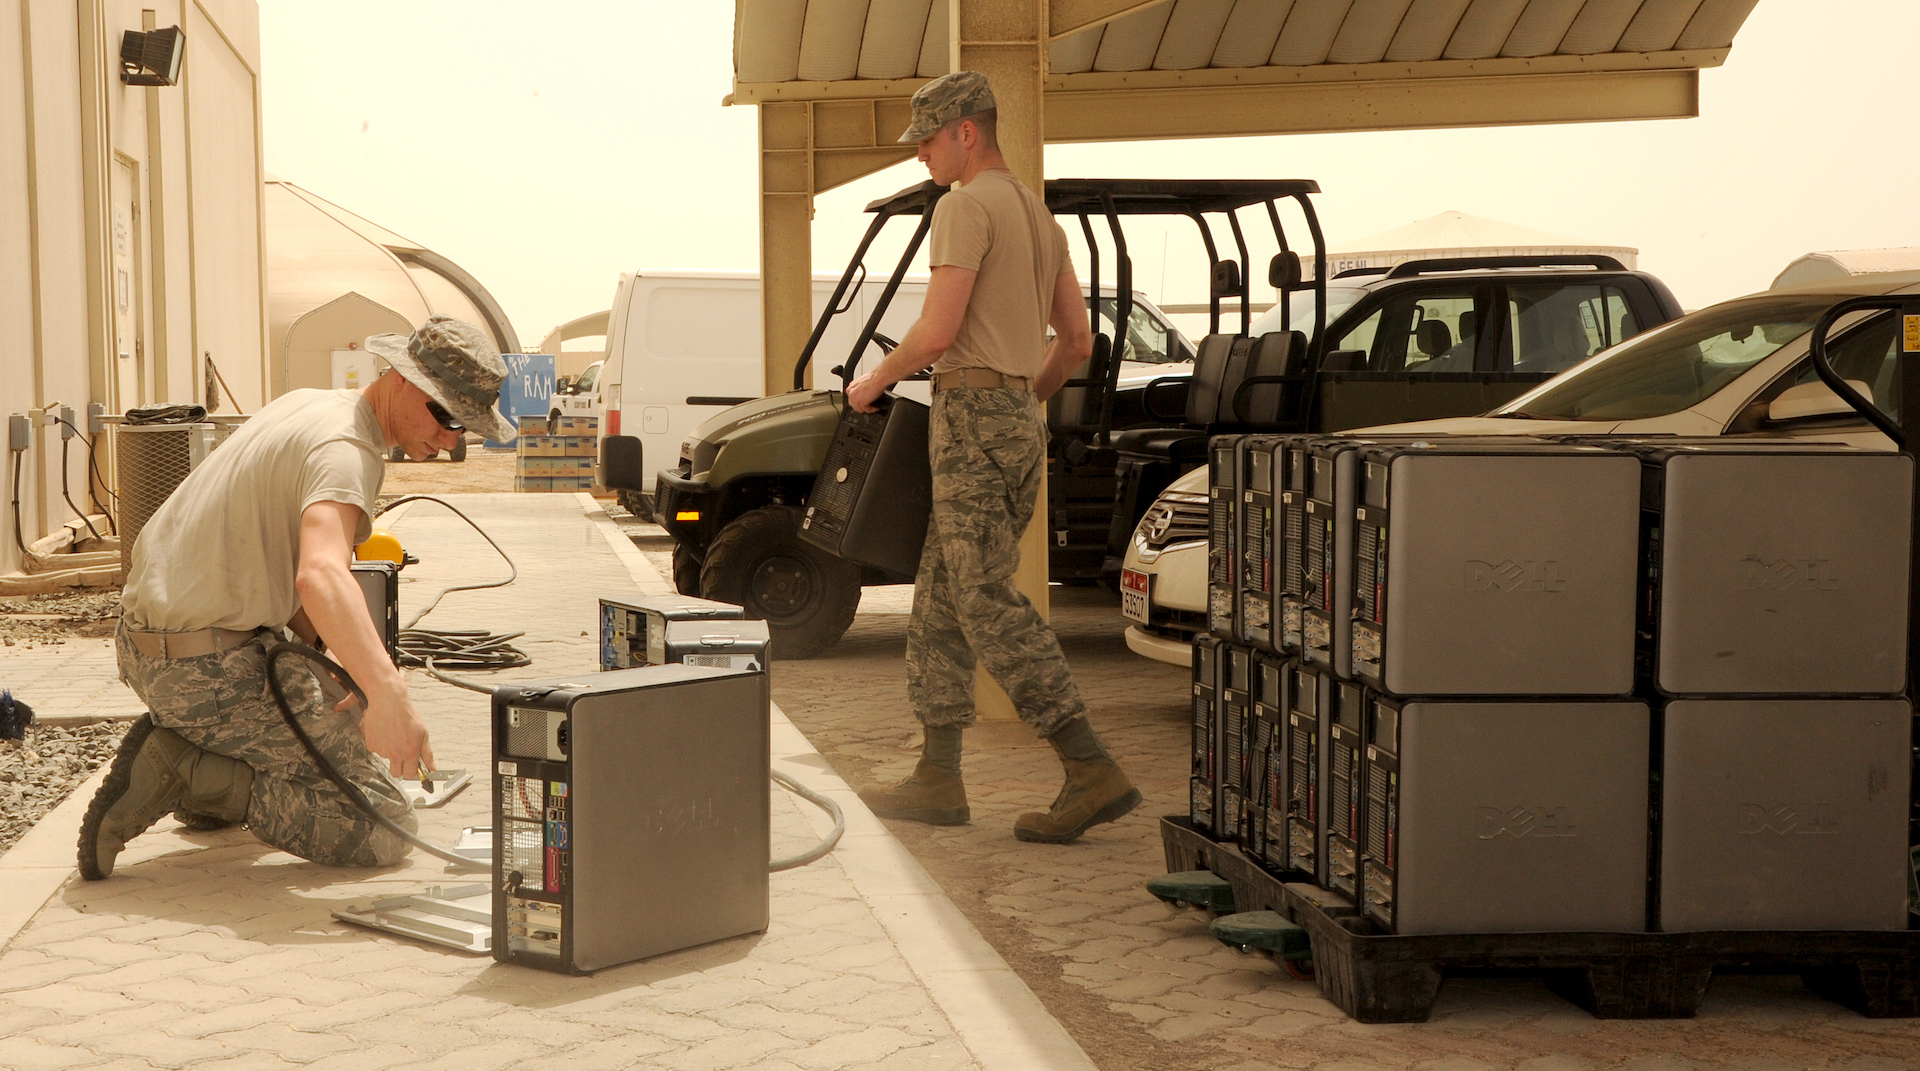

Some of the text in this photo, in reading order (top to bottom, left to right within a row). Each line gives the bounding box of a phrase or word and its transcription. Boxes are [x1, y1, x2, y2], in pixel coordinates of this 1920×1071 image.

[511, 354, 531, 377] THE
[524, 373, 553, 401] RAM
[1463, 559, 1567, 593] DELL
[1126, 592, 1144, 618] 53507
[1475, 804, 1578, 839] DELL
